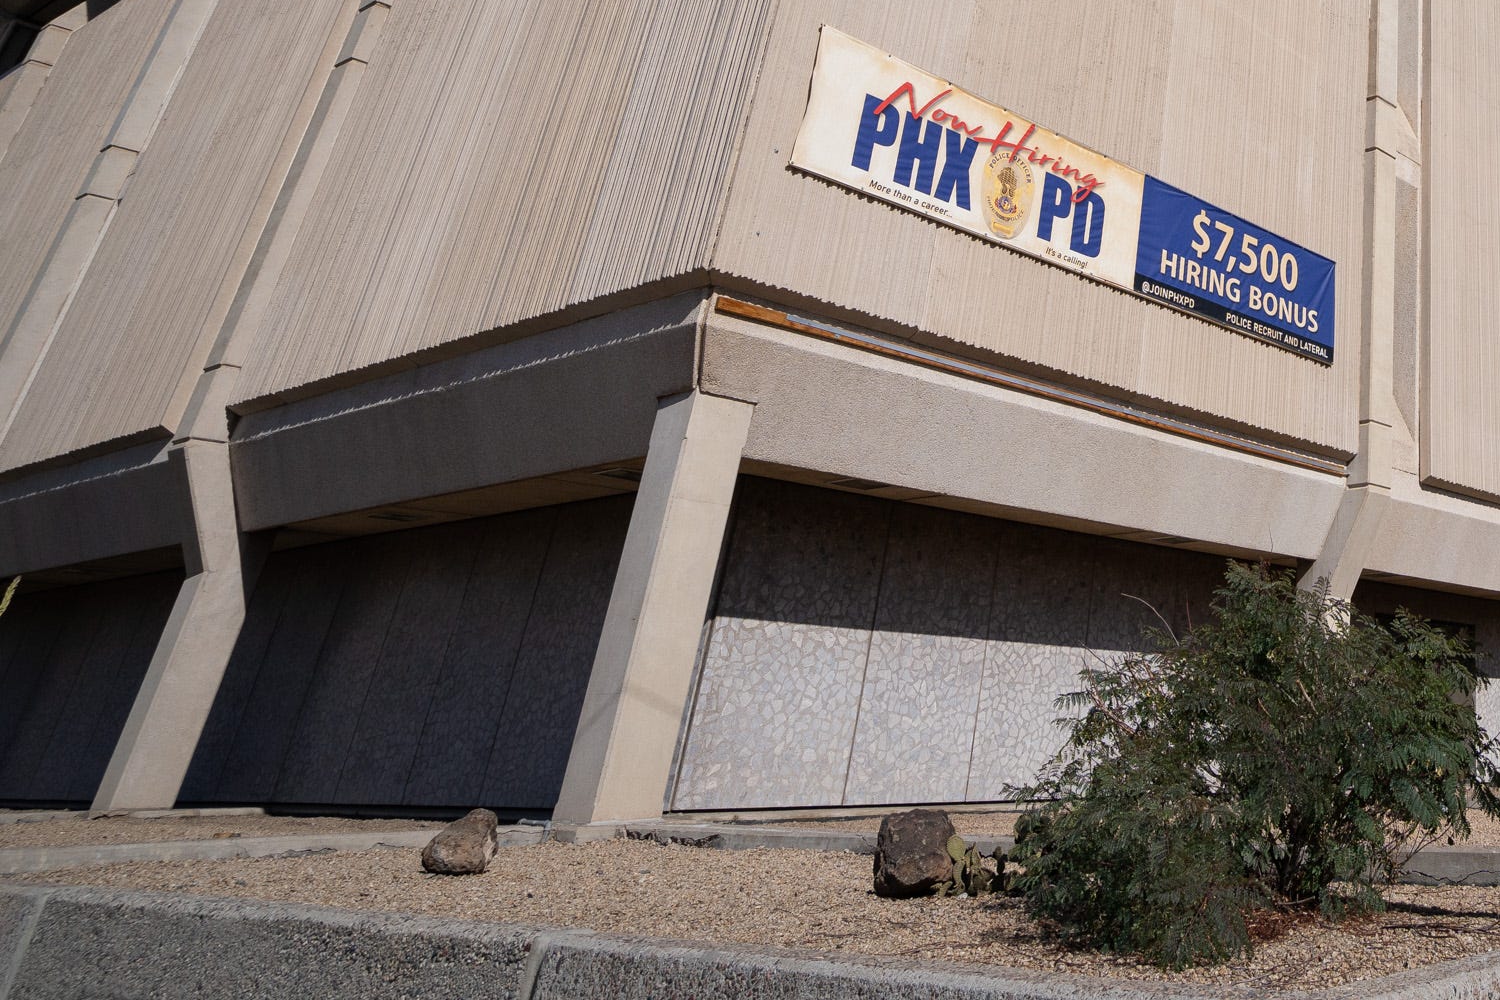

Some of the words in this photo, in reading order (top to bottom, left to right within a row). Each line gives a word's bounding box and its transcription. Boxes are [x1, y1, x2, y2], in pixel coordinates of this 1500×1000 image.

[873, 81, 983, 136] Now
[974, 120, 1104, 203] Hiring
[851, 93, 979, 211] PHX
[1037, 171, 1105, 258] PD
[869, 179, 892, 195] More
[893, 188, 912, 205] than
[913, 198, 920, 206] a
[1063, 253, 1089, 269] calling!
[1190, 209, 1298, 292] $7,500
[1142, 280, 1195, 309] @JOINPHXPD
[1160, 248, 1241, 303] HIRING
[1248, 284, 1319, 333] BONUS
[1226, 312, 1252, 330] POLICE
[1253, 322, 1282, 341] RECRUIT
[1284, 333, 1299, 348] AND
[1299, 341, 1328, 359] LATERAL
